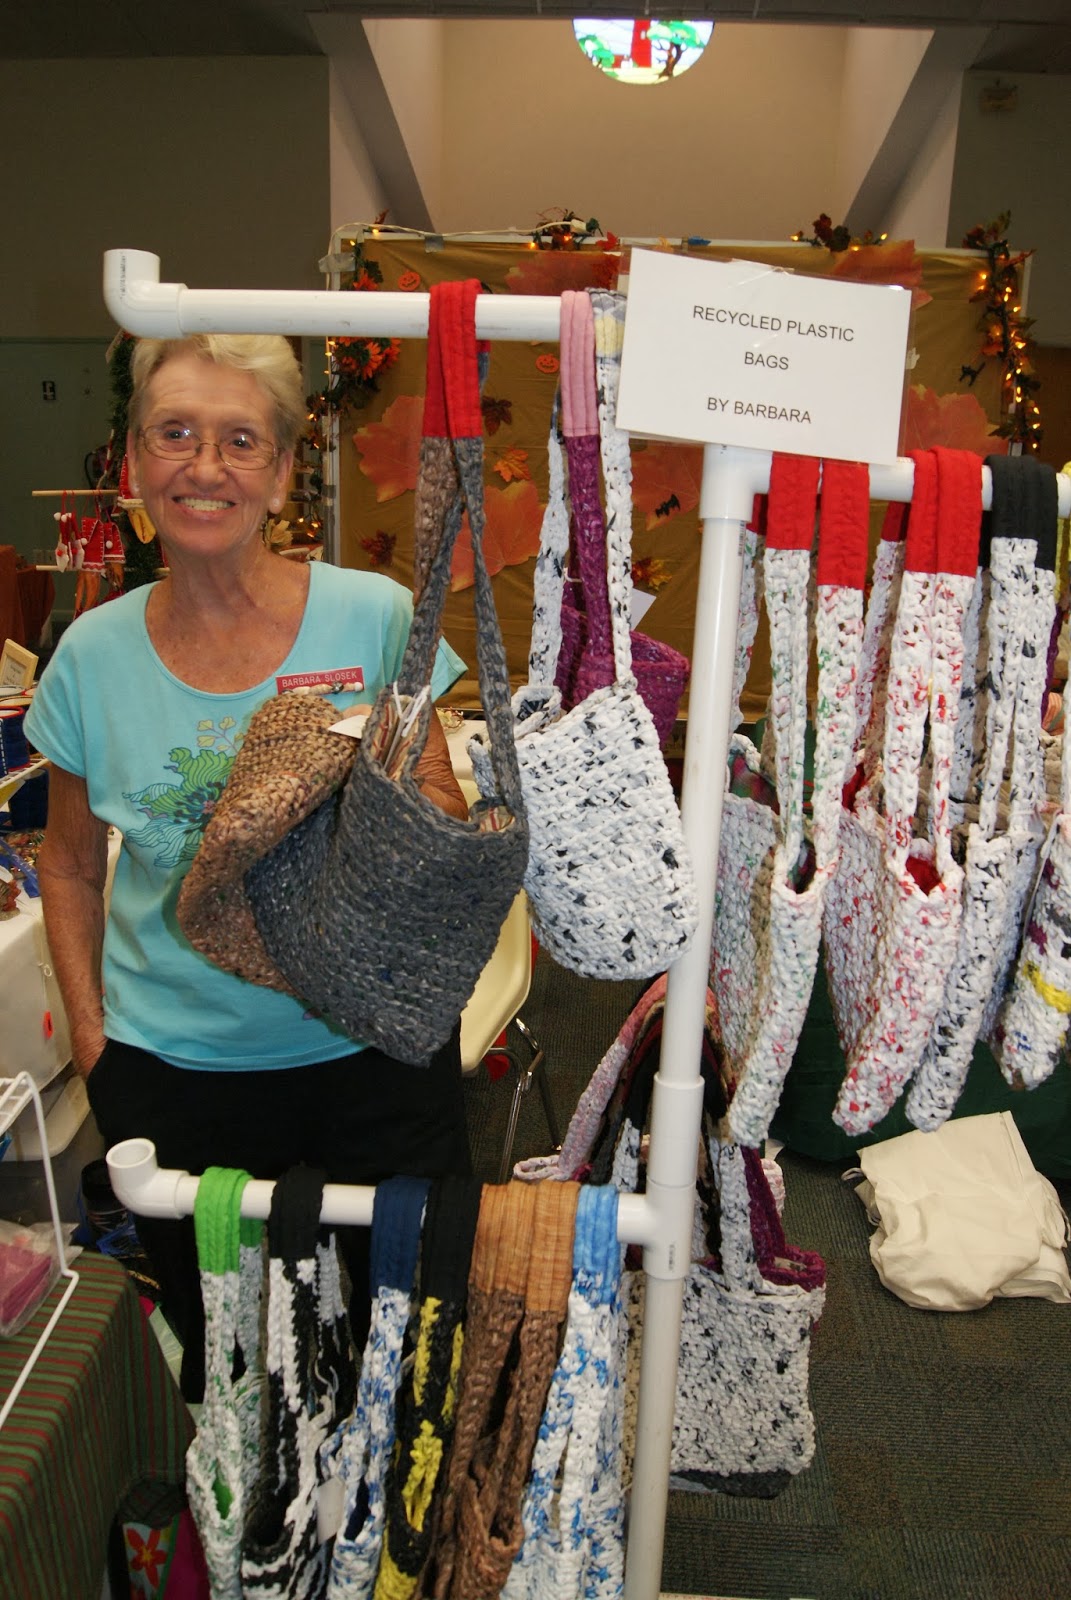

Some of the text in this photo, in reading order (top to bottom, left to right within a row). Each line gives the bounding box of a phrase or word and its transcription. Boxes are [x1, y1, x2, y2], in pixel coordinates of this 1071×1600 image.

[693, 305, 855, 342] RECYCLED PLASTIC
[743, 351, 789, 370] BAGS
[706, 397, 812, 424] BY BARBARA
[281, 671, 357, 687] BARBARA SLOSEK
